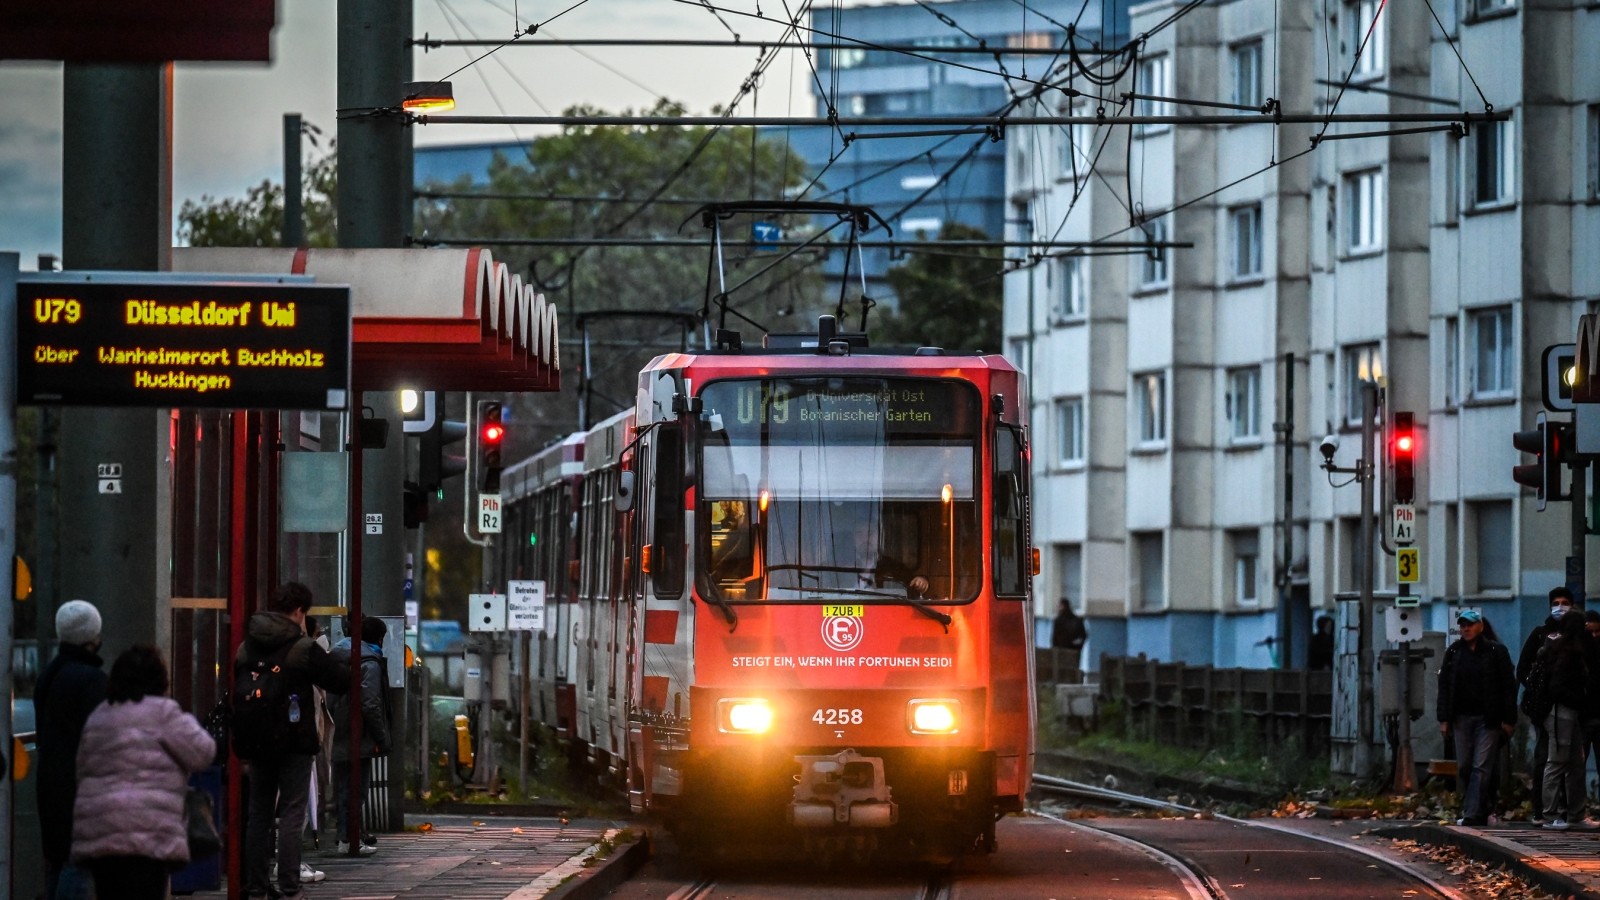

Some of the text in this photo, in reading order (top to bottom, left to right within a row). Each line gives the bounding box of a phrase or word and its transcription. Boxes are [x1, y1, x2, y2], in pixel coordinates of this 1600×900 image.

[35, 299, 81, 324] U79
[127, 300, 251, 327] Düsseldorf
[98, 346, 231, 367] Wanheimerort
[237, 349, 324, 368] Buchholz
[135, 371, 231, 393] Huckingen
[737, 386, 789, 424] U79
[902, 390, 926, 402] Ost
[799, 408, 932, 422] Botanischer Garten
[106, 482, 114, 491] 4
[482, 499, 499, 511] Plh
[1396, 509, 1413, 521] Plh
[832, 606, 854, 616] ZUB
[842, 633, 853, 642] 95
[732, 656, 953, 668] STEIGT EIN, WENN IHR FORTUNEN SEID!
[812, 708, 863, 725] 4258
